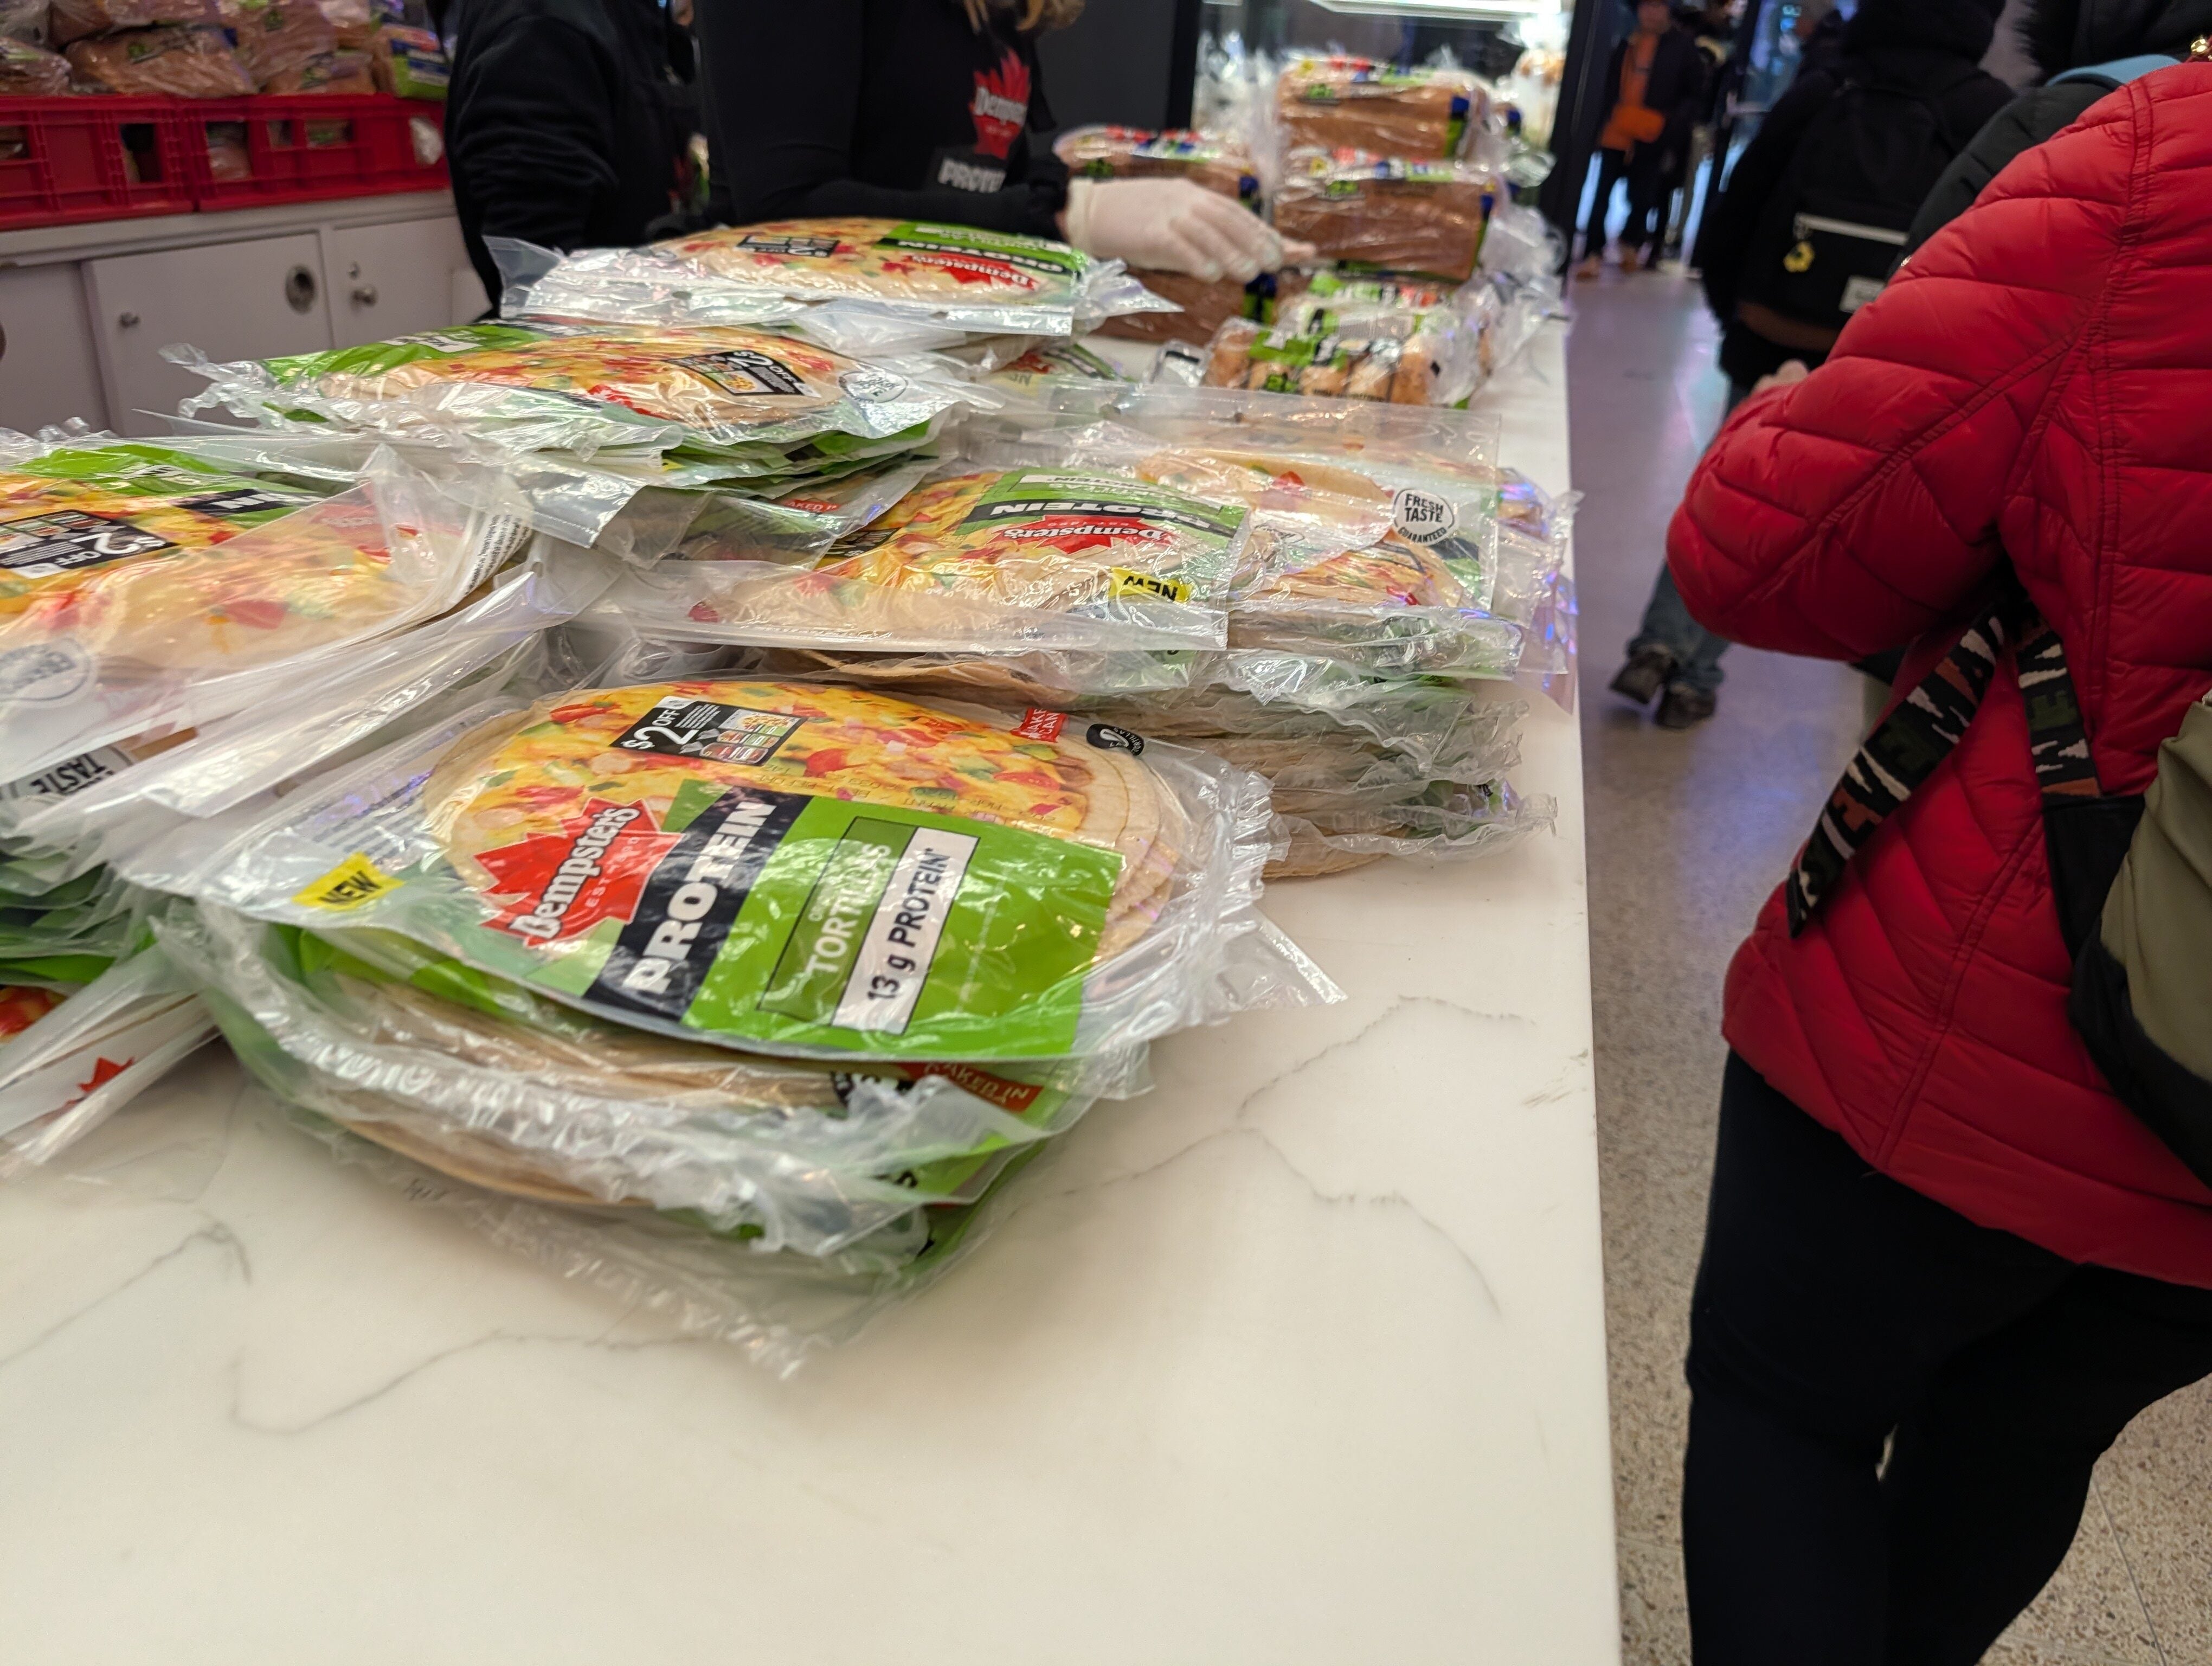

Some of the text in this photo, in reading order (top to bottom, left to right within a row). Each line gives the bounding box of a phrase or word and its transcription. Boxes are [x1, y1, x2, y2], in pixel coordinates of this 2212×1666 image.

[726, 351, 774, 368] $2
[769, 365, 797, 383] OFF
[990, 501, 1211, 529] PROTEIN
[1404, 492, 1445, 515] FRESH
[1404, 507, 1443, 523] TASTE
[68, 531, 166, 555] $2
[1004, 524, 1167, 540] Dempster's
[1397, 527, 1448, 543] GUARANTEED
[54, 550, 102, 566] OFF
[1123, 575, 1179, 601] NEW
[652, 709, 681, 727] OFF
[621, 726, 699, 750] $2
[507, 806, 641, 939] Dempster's
[318, 870, 382, 904] NEW
[622, 802, 777, 995] PROTEIN
[806, 844, 891, 973] TORTILLAS
[867, 975, 900, 1001] 13
[887, 953, 916, 973] g
